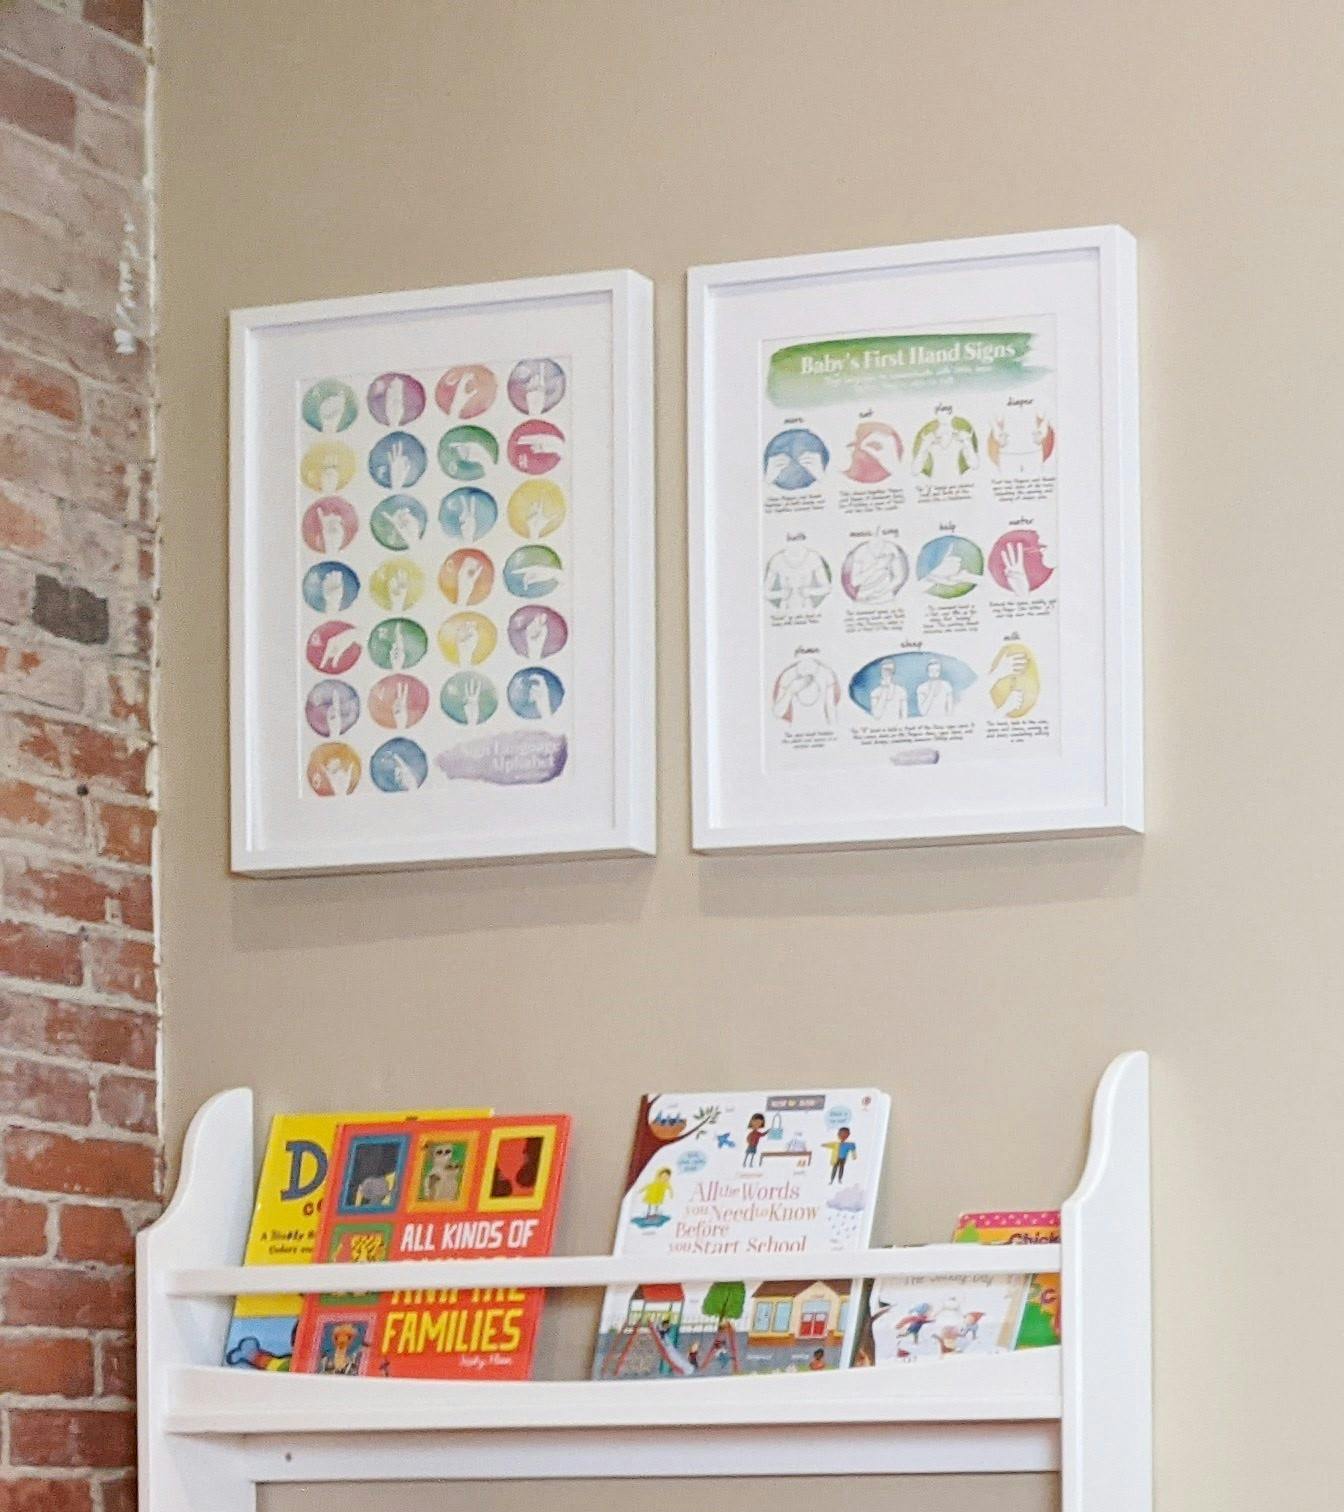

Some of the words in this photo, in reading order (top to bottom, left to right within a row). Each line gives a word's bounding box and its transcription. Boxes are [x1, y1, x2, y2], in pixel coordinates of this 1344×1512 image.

[801, 352, 860, 375] Baby's
[863, 346, 906, 370] First
[909, 341, 960, 366] Hand
[963, 341, 1016, 364] Signs
[690, 1180, 719, 1202] All
[741, 1181, 800, 1201] Words
[710, 1202, 755, 1222] Need
[767, 1202, 820, 1222] Know
[400, 1223, 436, 1252] ALL
[440, 1220, 506, 1250] KINDS
[506, 1218, 541, 1249] OF
[675, 1220, 730, 1240] Before
[745, 1235, 808, 1254] School
[381, 1307, 524, 1354] FAMILIES
